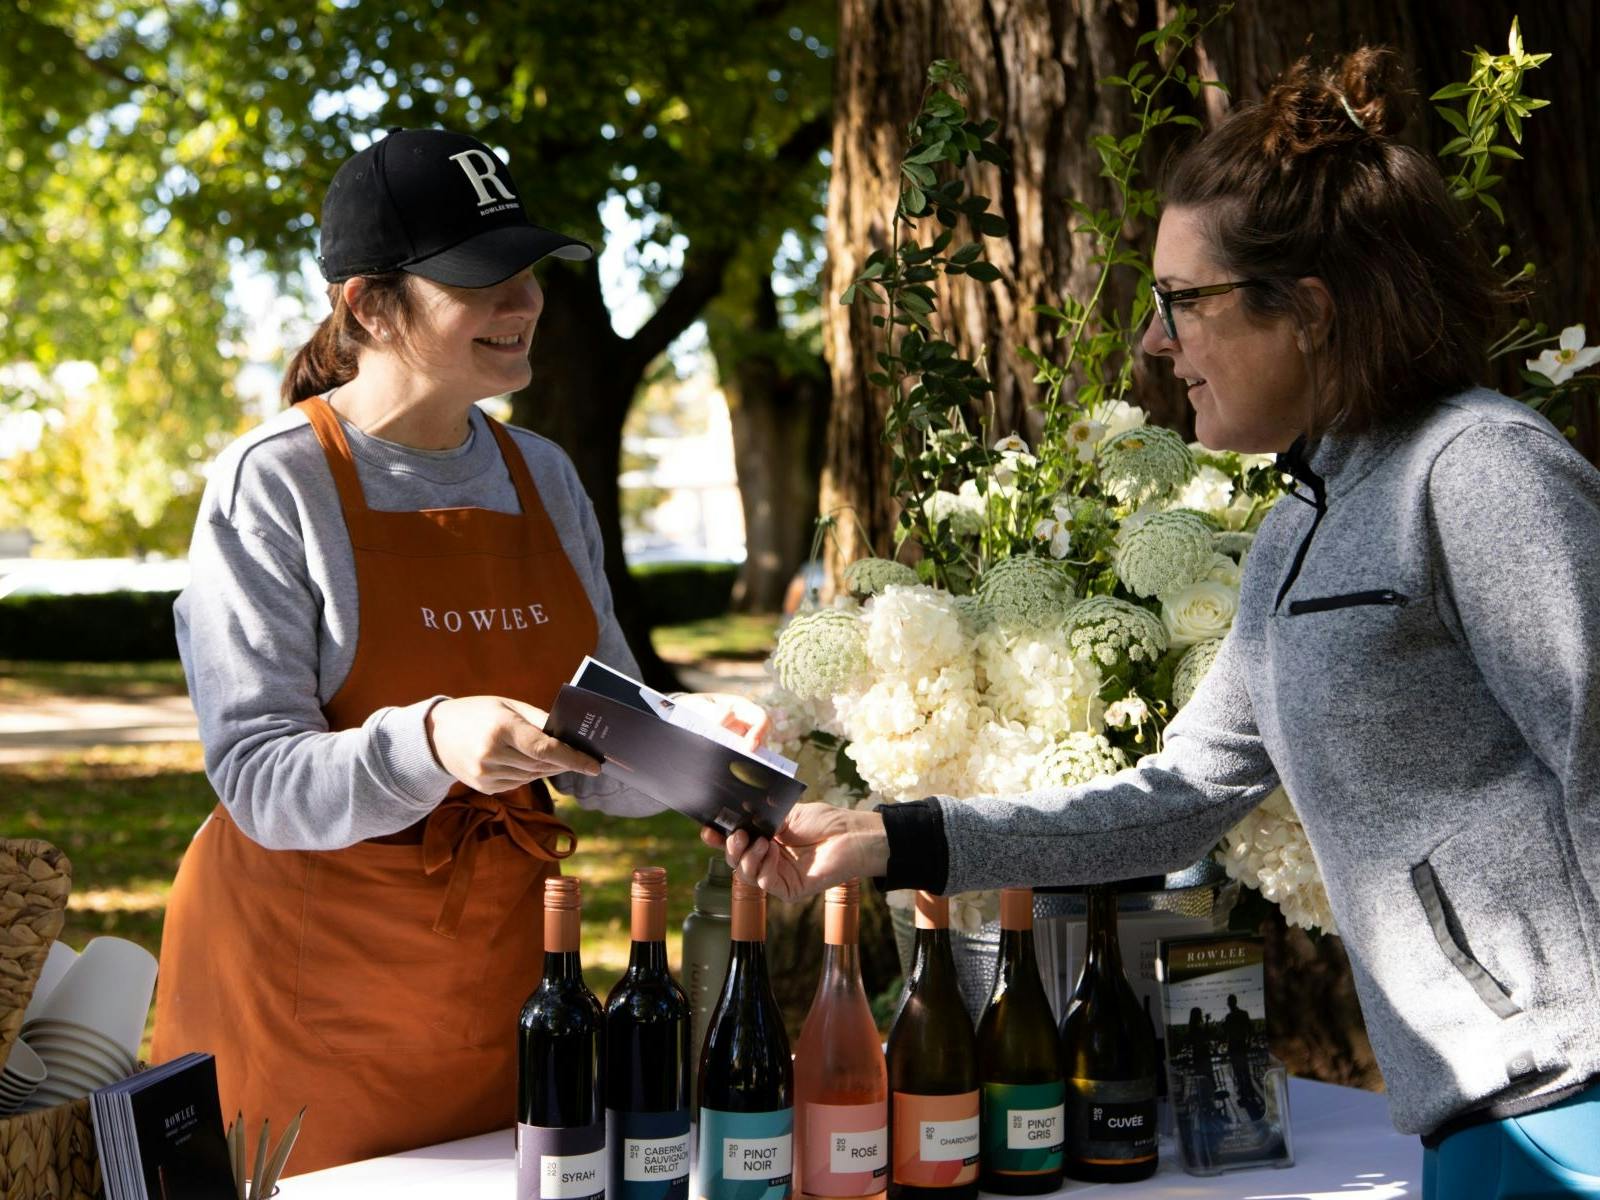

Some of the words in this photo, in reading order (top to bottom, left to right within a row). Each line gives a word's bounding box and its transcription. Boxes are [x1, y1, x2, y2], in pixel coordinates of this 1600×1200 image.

[448, 149, 517, 206] R
[421, 603, 549, 633] ROWLEE
[1187, 947, 1246, 962] ROWLEE
[164, 1104, 195, 1129] ROWLEE
[1027, 1117, 1057, 1130] PINOT
[1107, 1114, 1144, 1128] CUVÉE
[1027, 1129, 1051, 1141] GRIS
[644, 1142, 686, 1156] CABERNET
[744, 1147, 777, 1160] PINOT
[644, 1151, 689, 1166] SAUVIGNON
[743, 1160, 772, 1171] NOIR
[644, 1162, 679, 1174] MERLOT
[561, 1169, 596, 1184] SYRAH
